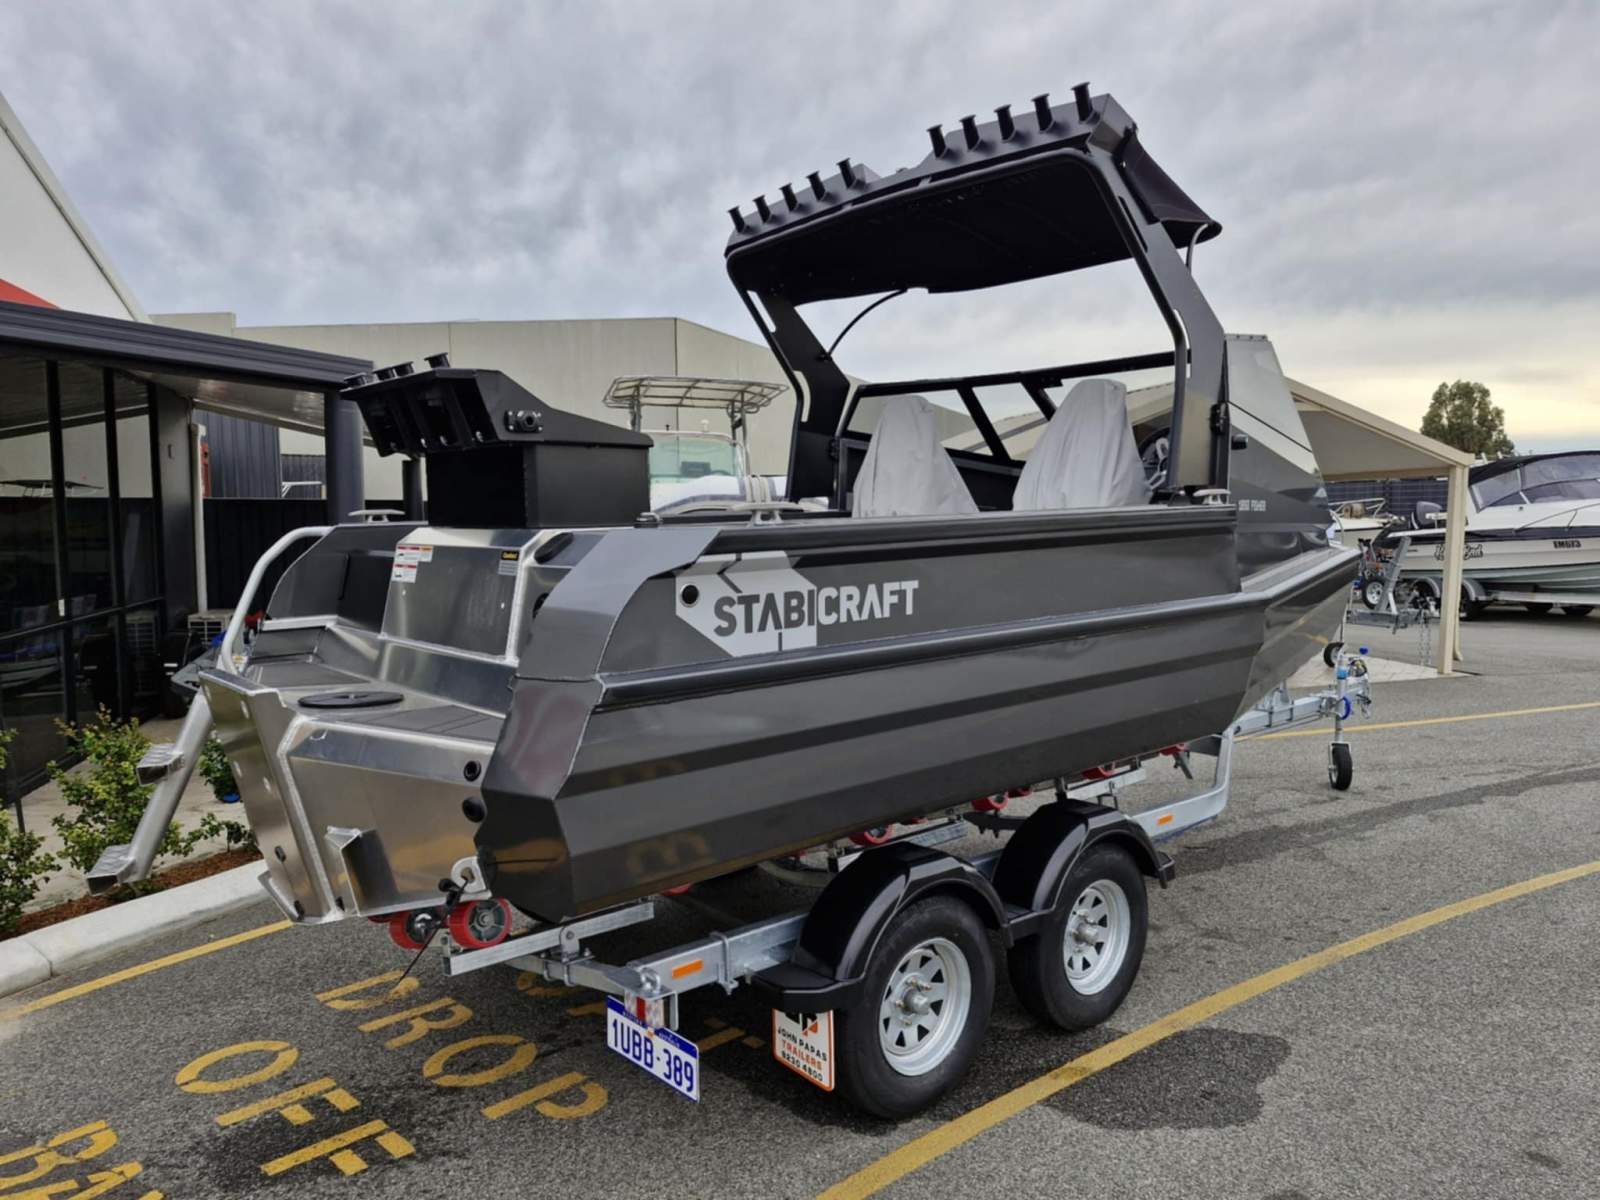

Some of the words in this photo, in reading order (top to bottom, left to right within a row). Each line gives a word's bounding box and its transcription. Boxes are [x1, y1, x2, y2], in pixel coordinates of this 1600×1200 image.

[713, 579, 919, 637] STABICRAFT
[315, 970, 608, 1120] DROP
[778, 1027, 797, 1044] JOHN
[799, 1038, 827, 1062] PAPAS
[782, 1040, 823, 1071] TRAILERS
[175, 1040, 416, 1176] OFF
